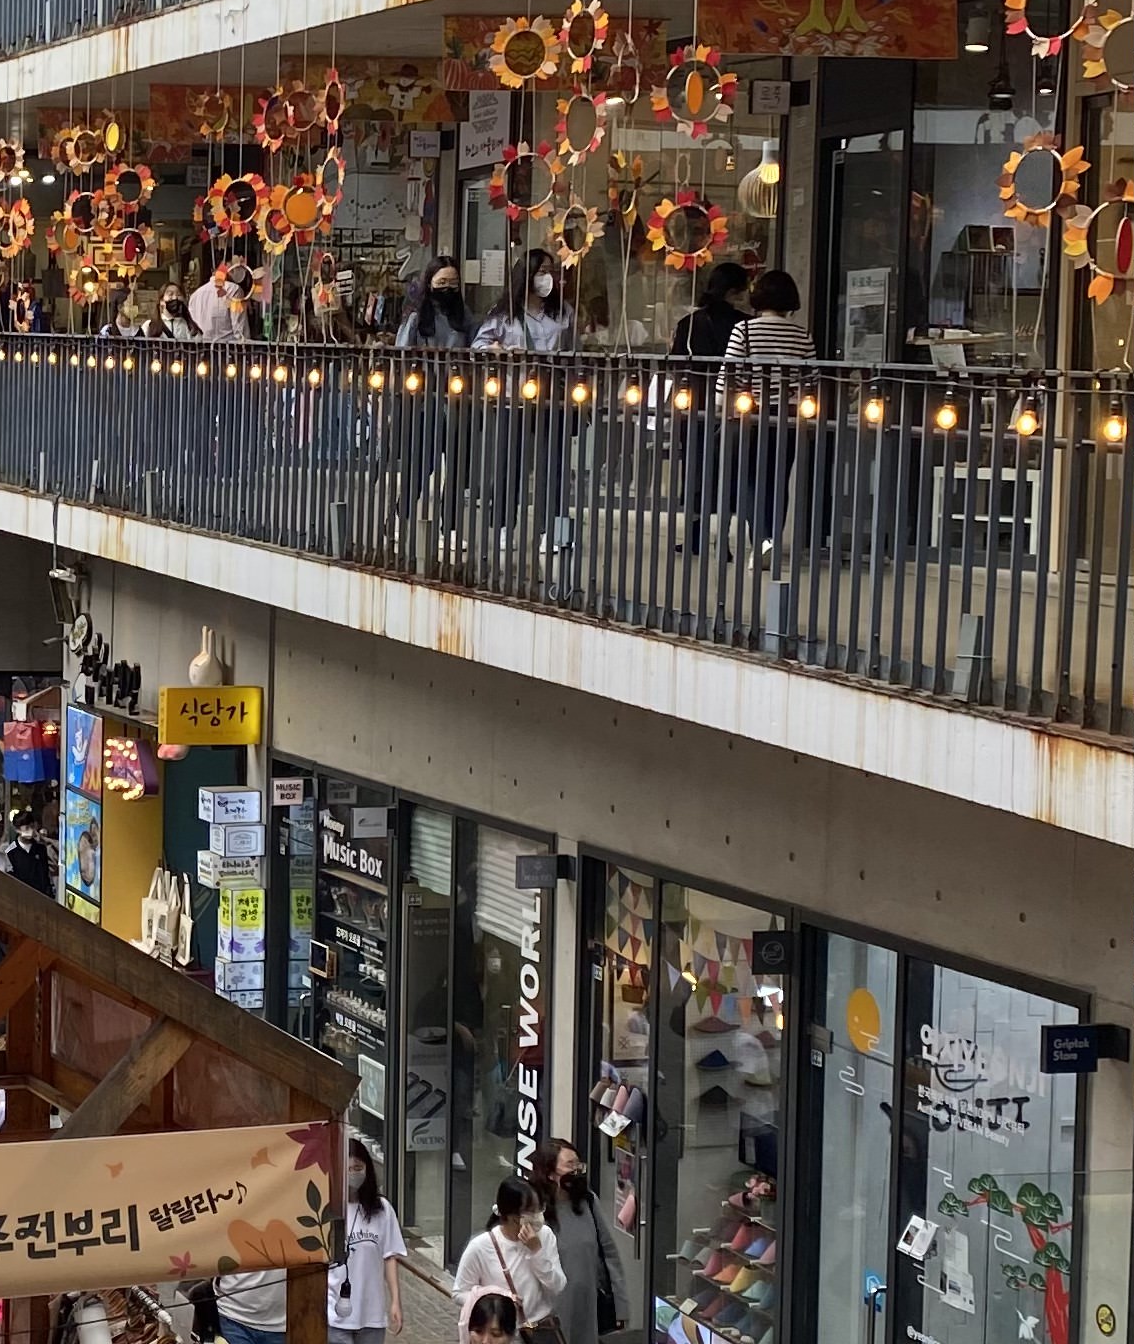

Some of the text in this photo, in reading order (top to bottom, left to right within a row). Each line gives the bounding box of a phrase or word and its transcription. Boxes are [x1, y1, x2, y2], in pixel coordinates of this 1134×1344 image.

[179, 697, 249, 728] 식당가
[275, 783, 302, 792] MUSIC
[279, 792, 297, 801] BOX
[322, 833, 383, 879] Music Box
[518, 889, 541, 1047] WORL
[1053, 1037, 1090, 1051] Griptok
[1053, 1051, 1079, 1062] Store
